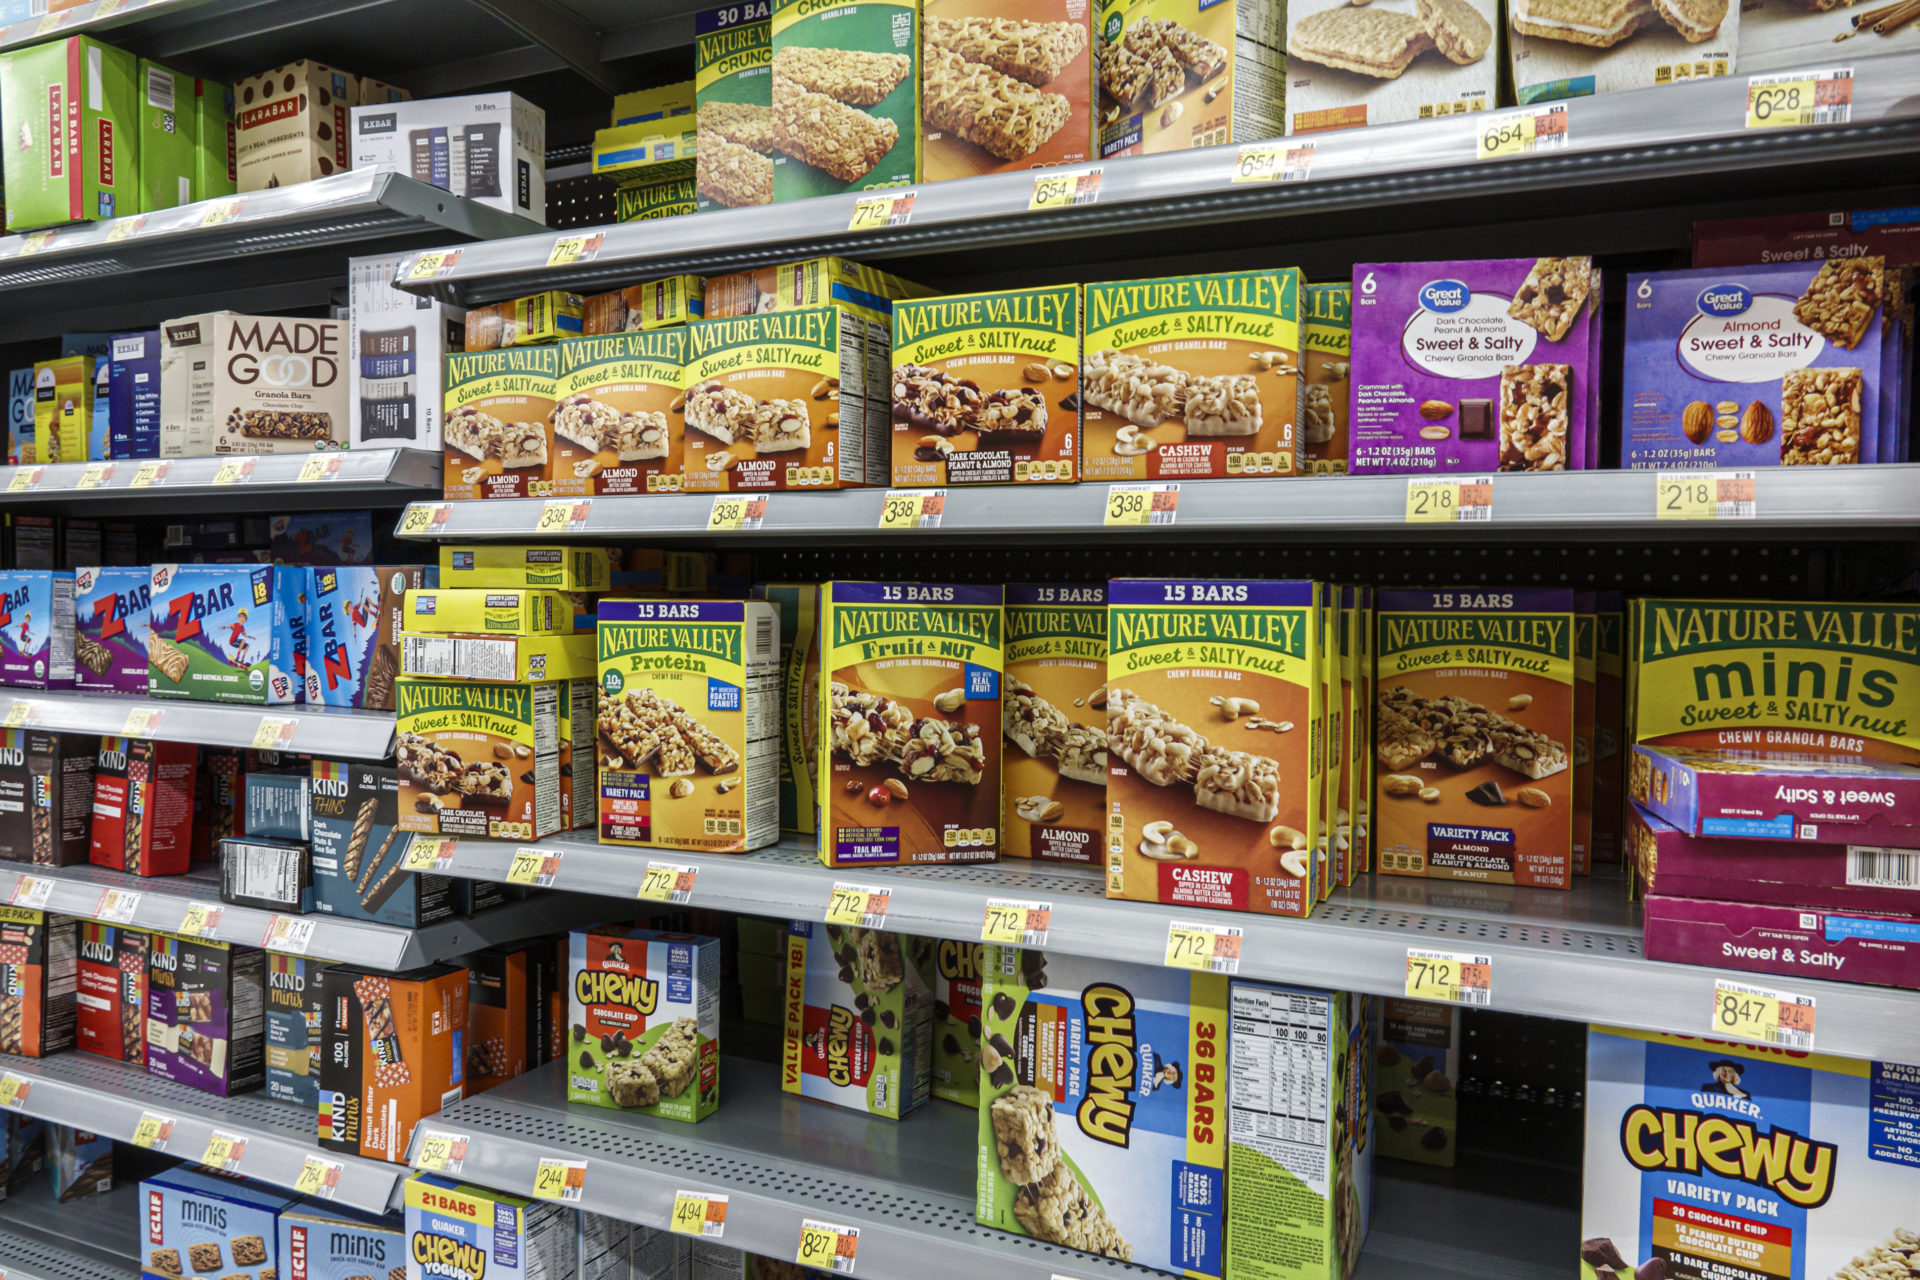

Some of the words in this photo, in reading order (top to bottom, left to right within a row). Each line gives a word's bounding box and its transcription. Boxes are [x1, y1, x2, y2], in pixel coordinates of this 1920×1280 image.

[718, 8, 739, 27] 30
[744, 0, 772, 18] BA
[699, 28, 756, 68] NATURE
[69, 101, 77, 115] 12
[243, 100, 294, 125] LARABAR
[474, 104, 482, 112] 10
[52, 90, 62, 169] LARABAR
[69, 120, 78, 155] BARS
[103, 124, 111, 181] LARABAR
[1093, 284, 1192, 328] NATURE
[1194, 275, 1289, 315] VALLEY
[1425, 288, 1462, 302] Great
[1433, 298, 1463, 307] Value
[1704, 292, 1743, 304] Great
[1713, 302, 1743, 311] Value
[898, 299, 982, 344] NATURE
[985, 292, 1068, 332] VALLEY
[1436, 317, 1456, 325] Dark
[1458, 317, 1505, 325] Chocolate,
[1722, 319, 1780, 332] Almond
[228, 320, 339, 354] MADE
[689, 320, 759, 360] NATURE
[759, 312, 831, 347] VALLEY
[1111, 321, 1169, 348] Sweet
[1174, 318, 1182, 331] &
[1187, 315, 1233, 333] SALTY
[1235, 320, 1274, 338] nut
[1434, 326, 1463, 334] Peanut
[1473, 325, 1506, 333] Almond
[914, 341, 962, 364] Sweet
[968, 335, 975, 347] &
[979, 332, 1019, 349] SALTY
[1021, 337, 1056, 354] nut
[1149, 342, 1172, 354] CHEWY
[1174, 341, 1206, 351] GRANOLA
[1209, 341, 1227, 350] BARS
[1416, 337, 1464, 351] Sweet
[1468, 337, 1480, 349] &
[1484, 336, 1523, 351] Salty
[1690, 335, 1744, 352] Sweet
[1750, 335, 1762, 348] &
[1768, 333, 1813, 349] Salty
[561, 338, 624, 372] NATURE
[1425, 355, 1455, 364] Chewy
[1457, 354, 1494, 362] Granola
[1496, 353, 1514, 361] Bars
[255, 390, 290, 400] Granola
[293, 390, 312, 400] Bars
[291, 401, 304, 409] Chip
[950, 452, 967, 461] DARK
[969, 450, 1010, 460] CHOCOLATE,
[1159, 444, 1212, 457] CASHEW
[737, 461, 776, 471] ALMOND
[948, 461, 975, 470] PEANUT
[976, 461, 981, 469] &
[982, 460, 1012, 468] ALMOND
[1356, 457, 1370, 466] NET
[1372, 457, 1384, 466] WT
[1386, 457, 1397, 466] 7.4
[1398, 457, 1410, 466] OZ
[1411, 457, 1436, 467] (210g)
[487, 475, 520, 484] ALMOND
[602, 468, 638, 478] ALMOND
[883, 586, 902, 600] 15
[907, 586, 954, 601] BARS
[1164, 585, 1185, 600] 15
[1191, 585, 1248, 601] BARS
[638, 605, 655, 618] 15
[658, 604, 699, 618] BARS
[839, 610, 927, 643] NATURE
[927, 611, 995, 645] VALLEY
[1115, 613, 1207, 649] NATURE
[1209, 613, 1299, 653] VALLEY
[1386, 618, 1473, 651] NATURE
[1478, 619, 1562, 654] VALLEY
[1654, 607, 1798, 656] NATURE
[603, 628, 669, 657] NATURE
[671, 628, 736, 660] VALLEY
[862, 638, 922, 660] Fruit
[927, 640, 936, 652] &
[940, 642, 975, 659] NUT
[631, 655, 707, 673] Protein
[971, 685, 990, 693] FRUIT
[972, 677, 990, 685] REAL
[710, 692, 738, 700] ROASTED
[710, 699, 738, 707] PEANUTS
[1718, 730, 1762, 745] CHEWY
[1766, 730, 1826, 747] GRANOLA
[1829, 734, 1864, 752] BARS
[99, 750, 127, 770] KIND
[312, 778, 349, 797] KIND
[315, 797, 345, 815] THINS
[1432, 826, 1478, 840] VARIETY
[1480, 829, 1509, 842] PACK
[854, 845, 869, 853] TRAIL
[871, 845, 883, 853] MIX
[1172, 868, 1233, 885] CASHEW
[602, 959, 630, 971] QUAKER
[1722, 942, 1778, 961] Sweet
[1781, 947, 1796, 963] &
[1799, 949, 1845, 970] Salty
[270, 972, 305, 991] KIND
[788, 976, 801, 1023] PACK
[593, 1008, 623, 1020] CHOCOLATE
[625, 1012, 638, 1021] CHIP
[1196, 1021, 1216, 1059] 36
[785, 1028, 799, 1085] VALUE
[366, 1086, 374, 1114] Butter
[1194, 1064, 1214, 1145] BARS
[1691, 1093, 1761, 1119] QUAKER
[330, 1091, 347, 1142] KIND
[379, 1104, 387, 1150] Chocolate
[422, 1192, 438, 1205] 21
[439, 1195, 476, 1216] BARS
[1667, 1179, 1732, 1207] VARIETY
[1737, 1193, 1779, 1217] PACK
[150, 1193, 162, 1232] CLIF
[1672, 1206, 1685, 1217] 20
[1688, 1209, 1742, 1229] CHOCOLATE
[1745, 1221, 1767, 1235] CHIP
[432, 1219, 467, 1236] QUAKER
